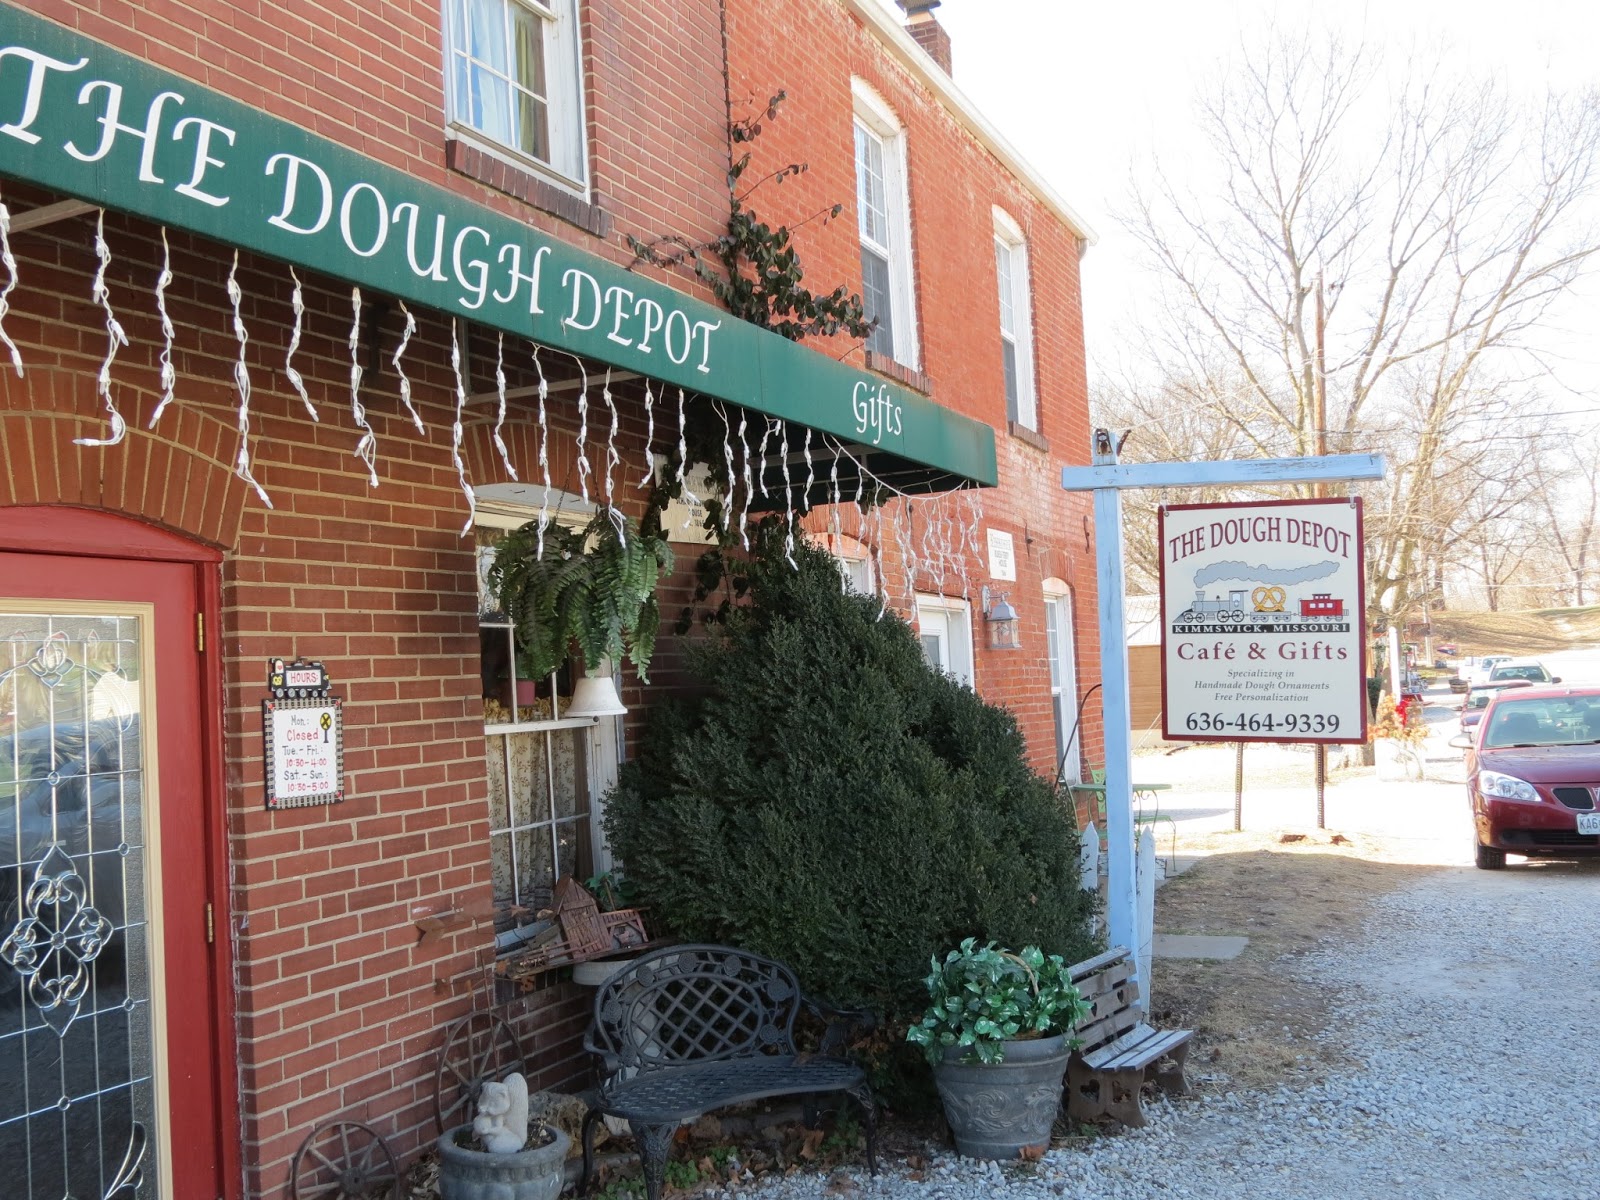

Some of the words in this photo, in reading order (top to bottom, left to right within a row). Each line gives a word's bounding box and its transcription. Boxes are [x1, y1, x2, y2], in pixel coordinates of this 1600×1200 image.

[0, 46, 237, 208] THE
[265, 152, 553, 316] DOUGH
[561, 268, 722, 374] DEPOT
[852, 381, 902, 445] Gifts
[1169, 526, 1206, 563] THE
[1210, 516, 1282, 549] DOUGH
[1286, 518, 1352, 559] DEPOT
[1174, 624, 1268, 634] KIMMSWICK,
[1273, 623, 1348, 633] MISSOURI
[1177, 641, 1236, 660] Café
[1247, 642, 1267, 660] &
[1278, 641, 1348, 660] Gifts
[290, 672, 319, 684] HOURS:
[1227, 669, 1283, 679] Specializing
[1285, 669, 1295, 678] in
[1194, 681, 1243, 690] Handmade
[1245, 681, 1275, 691] Dough
[1278, 681, 1330, 690] Ornaments
[1214, 693, 1233, 701] Free
[1235, 693, 1309, 702] Personalization
[1186, 712, 1340, 733] 636-464-9339
[286, 728, 319, 742] Closed
[1579, 817, 1600, 830] KA6
